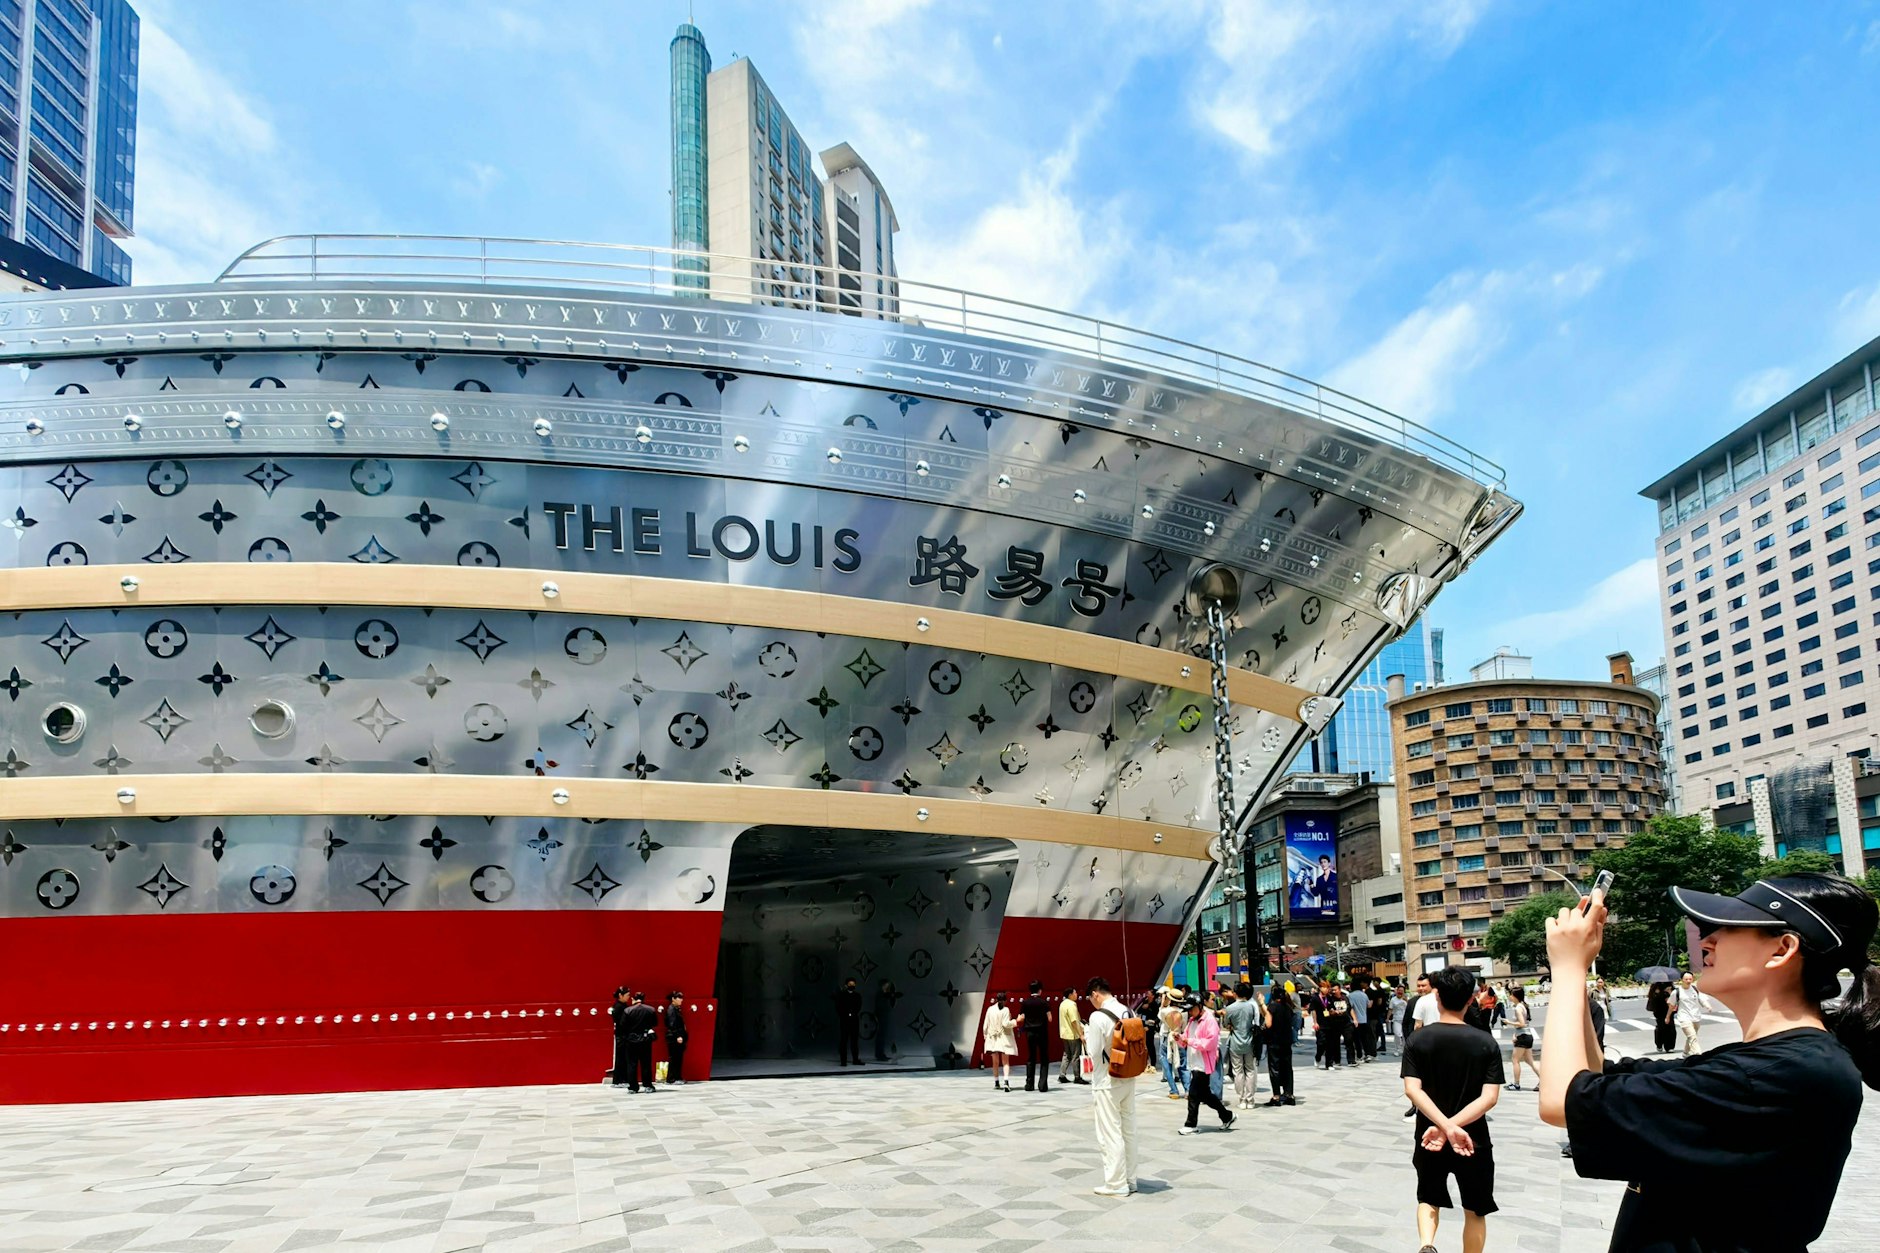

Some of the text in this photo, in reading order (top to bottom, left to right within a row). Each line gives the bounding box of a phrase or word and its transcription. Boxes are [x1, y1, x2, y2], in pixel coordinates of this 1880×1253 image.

[692, 315, 709, 334] LV
[725, 318, 743, 337] LV
[910, 342, 926, 362] LV
[939, 348, 956, 367] LV
[969, 352, 984, 372] LV
[997, 357, 1011, 376] LV
[1078, 374, 1090, 393] LV
[1102, 379, 1116, 398] LV
[543, 501, 862, 574] THE LOUIS
[908, 534, 1121, 618] 路易号
[1311, 832, 1329, 841] NO.1
[1426, 941, 1447, 950] ICBC
